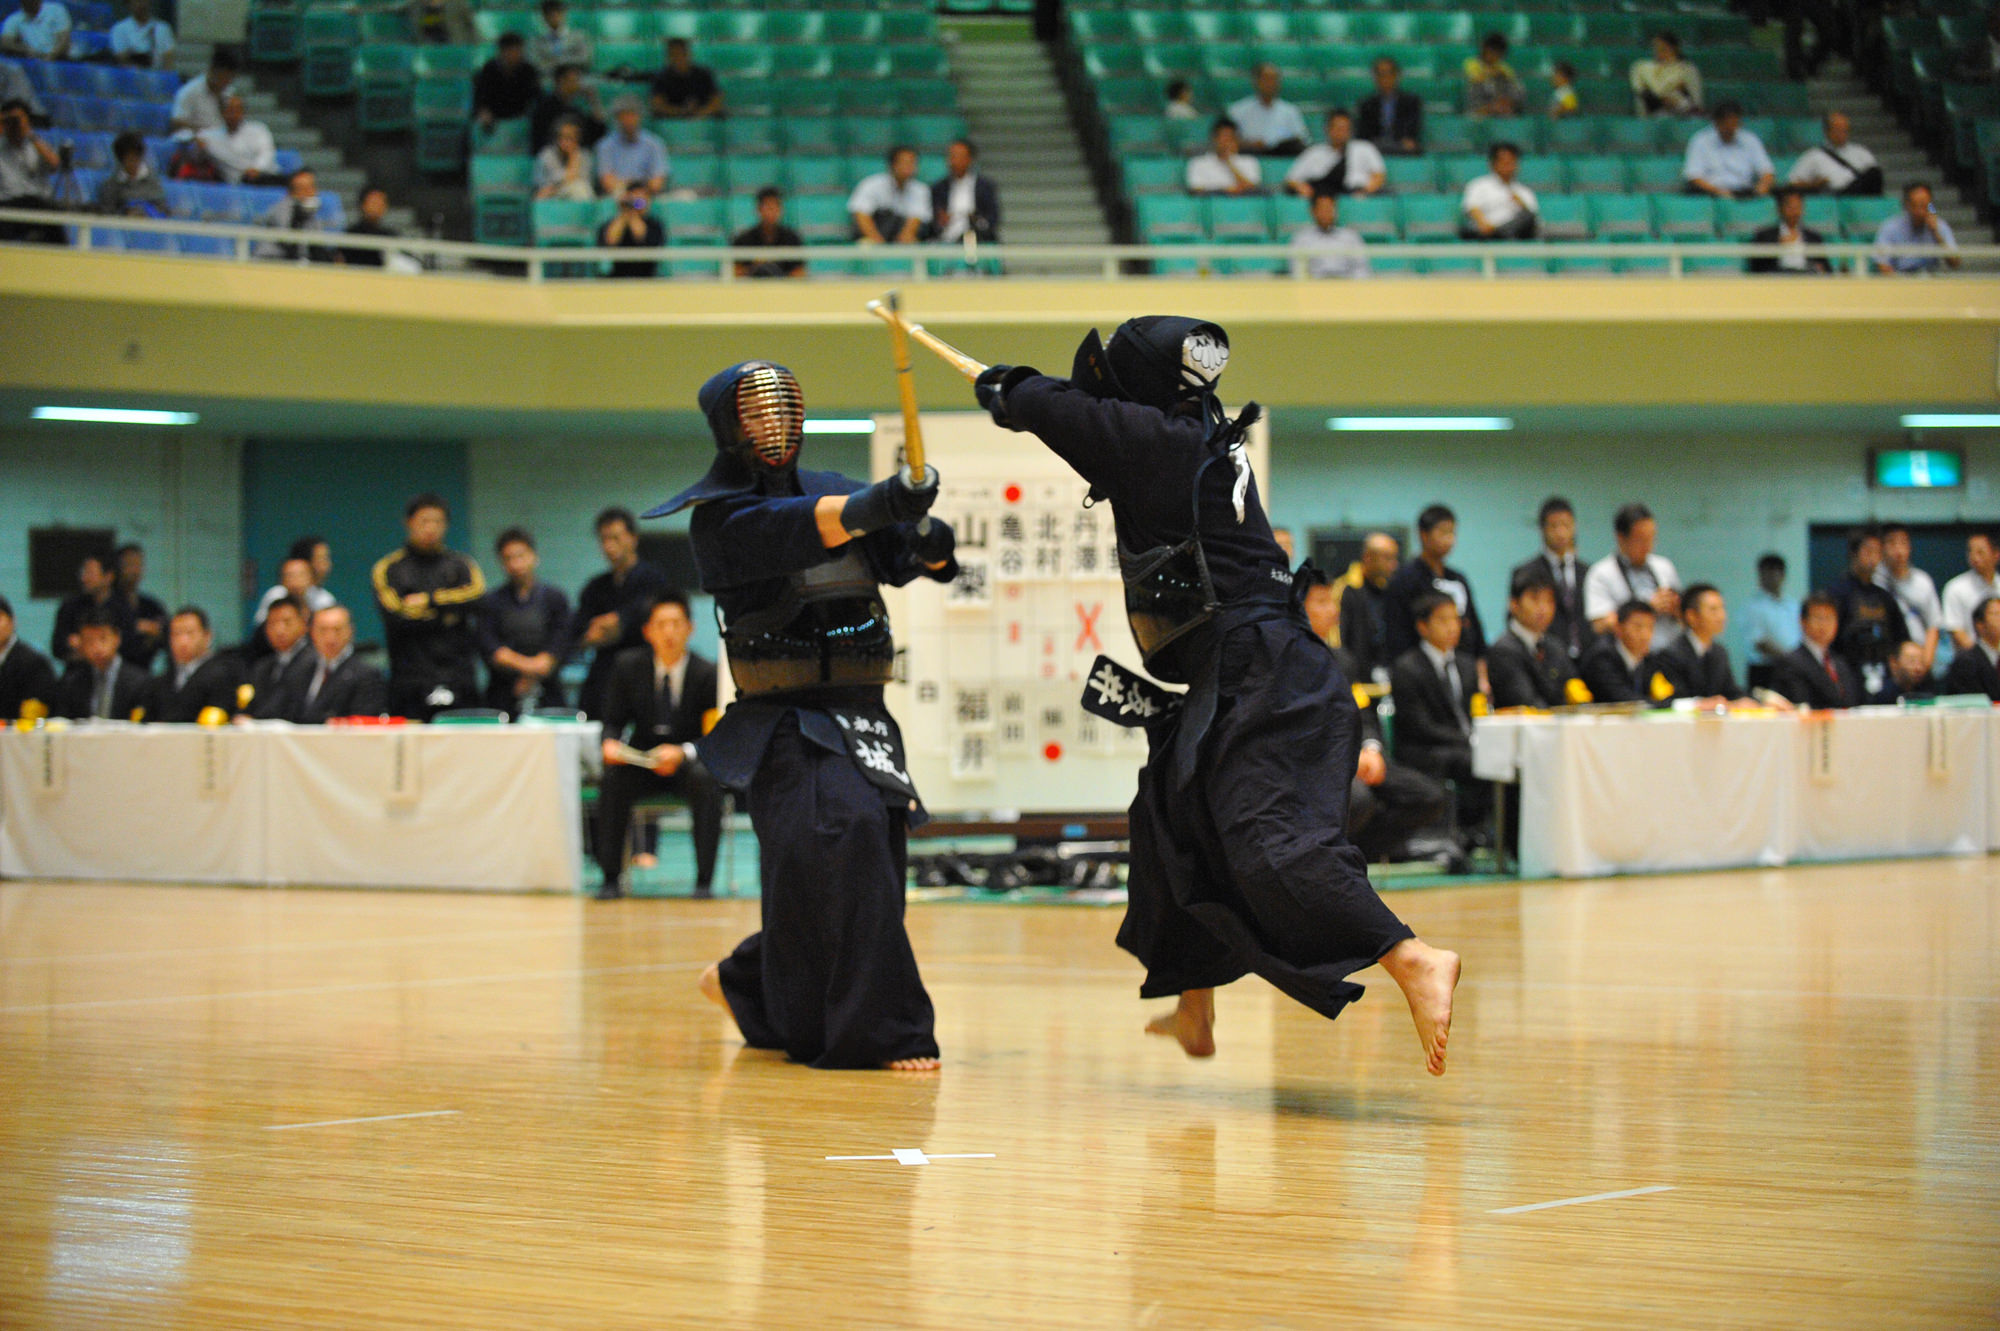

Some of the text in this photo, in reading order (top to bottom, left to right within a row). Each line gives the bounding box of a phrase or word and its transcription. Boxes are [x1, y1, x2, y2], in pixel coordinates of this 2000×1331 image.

[950, 512, 988, 599] 山梨
[1001, 513, 1023, 574] 亀谷
[1037, 513, 1063, 574] 北村
